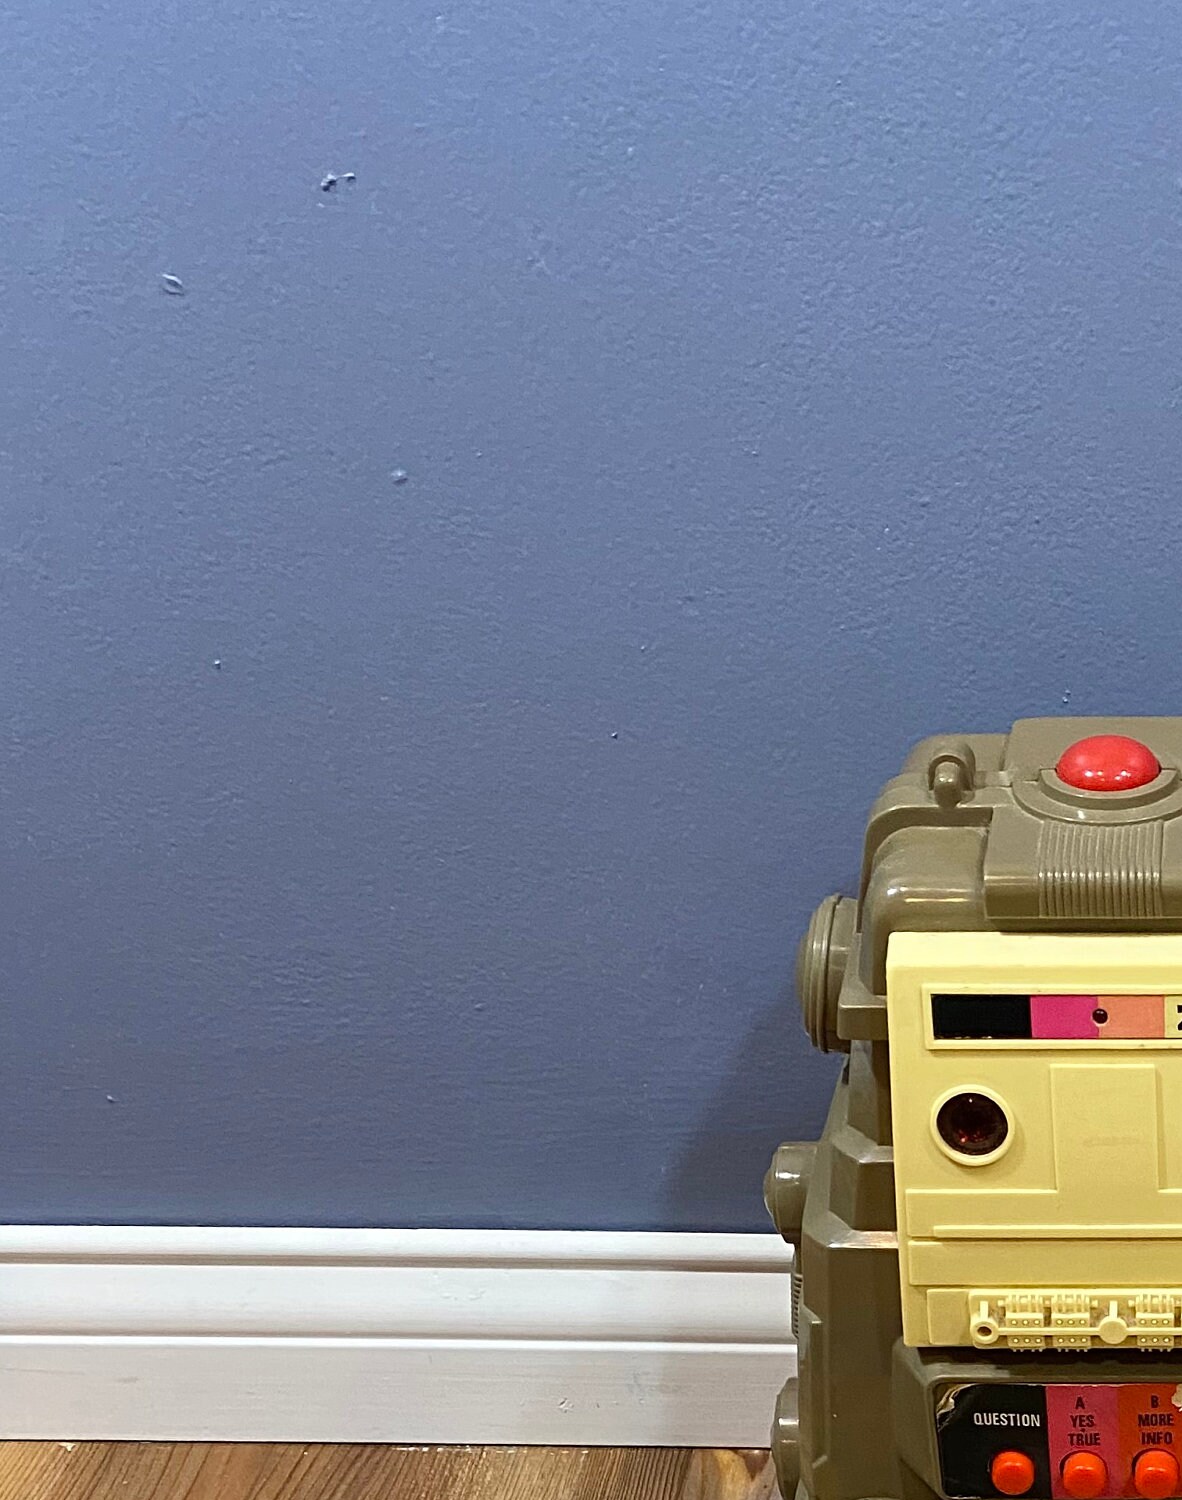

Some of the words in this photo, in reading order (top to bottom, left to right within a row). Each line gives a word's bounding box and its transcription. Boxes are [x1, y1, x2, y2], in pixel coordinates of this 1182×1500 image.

[1075, 1396, 1085, 1410] A
[1151, 1395, 1159, 1408] B
[973, 1412, 1040, 1427] QUESTION
[1070, 1415, 1095, 1428] YES
[1138, 1413, 1174, 1427] MORE
[1067, 1433, 1100, 1447] TRUE
[1141, 1431, 1173, 1445] INFO
